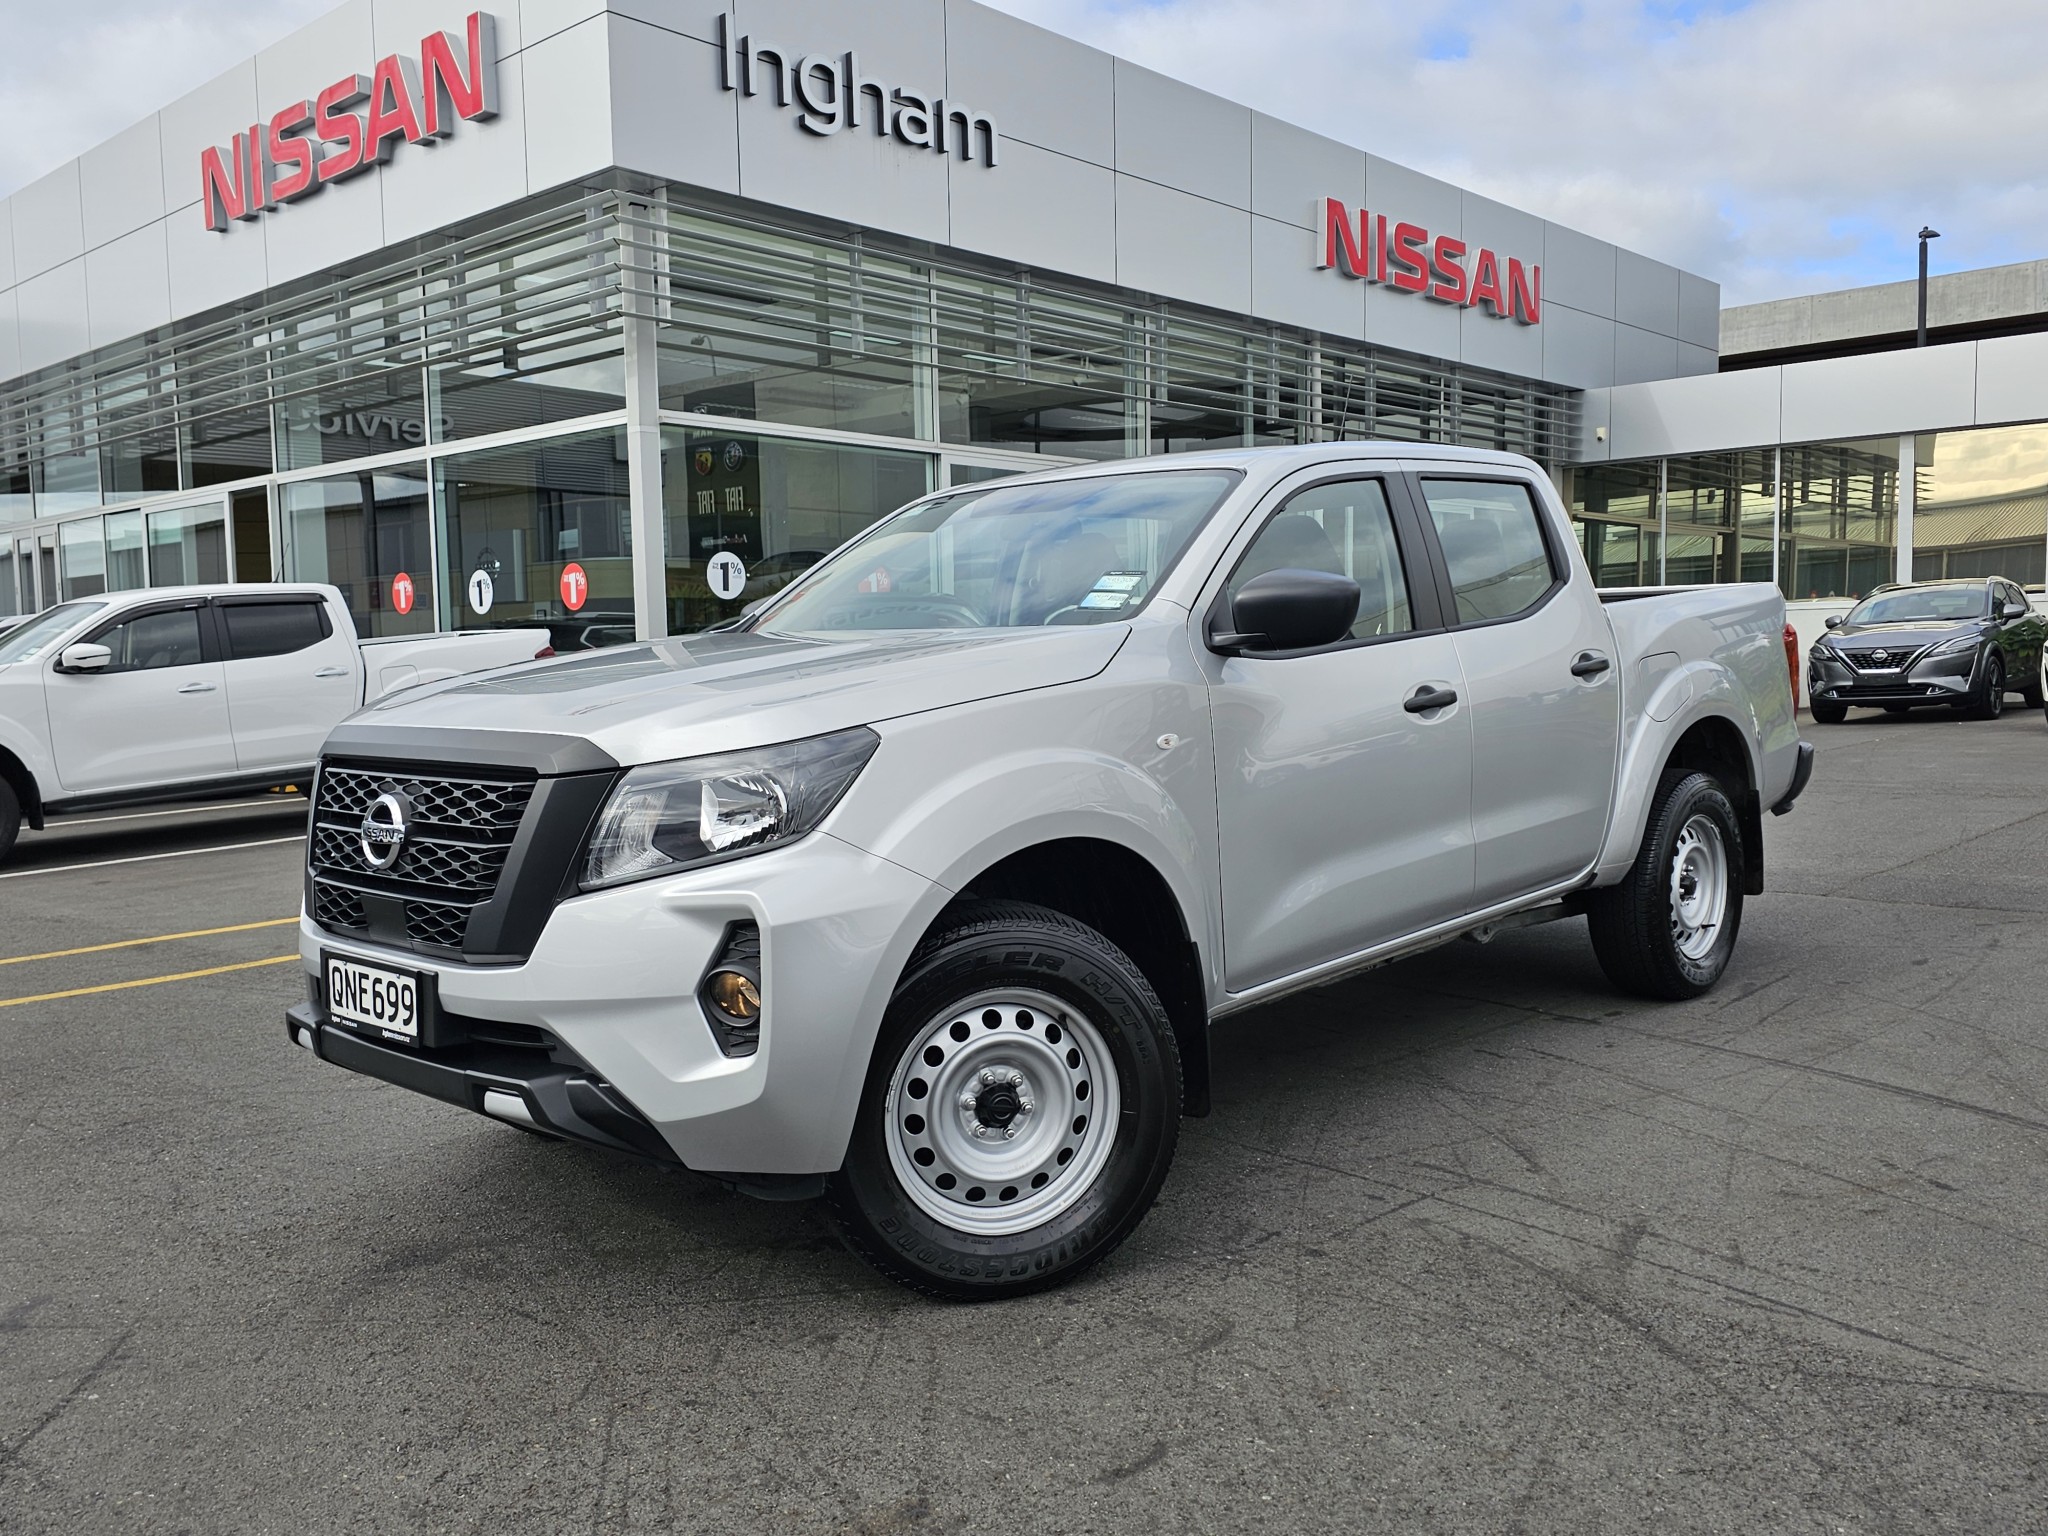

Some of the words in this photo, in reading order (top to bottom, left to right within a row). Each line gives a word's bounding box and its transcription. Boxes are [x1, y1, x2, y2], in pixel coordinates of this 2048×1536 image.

[201, 11, 499, 232] NISSAN
[719, 12, 999, 168] Ingham
[1317, 196, 1541, 326] NISSAN
[332, 965, 414, 1027] QNE699
